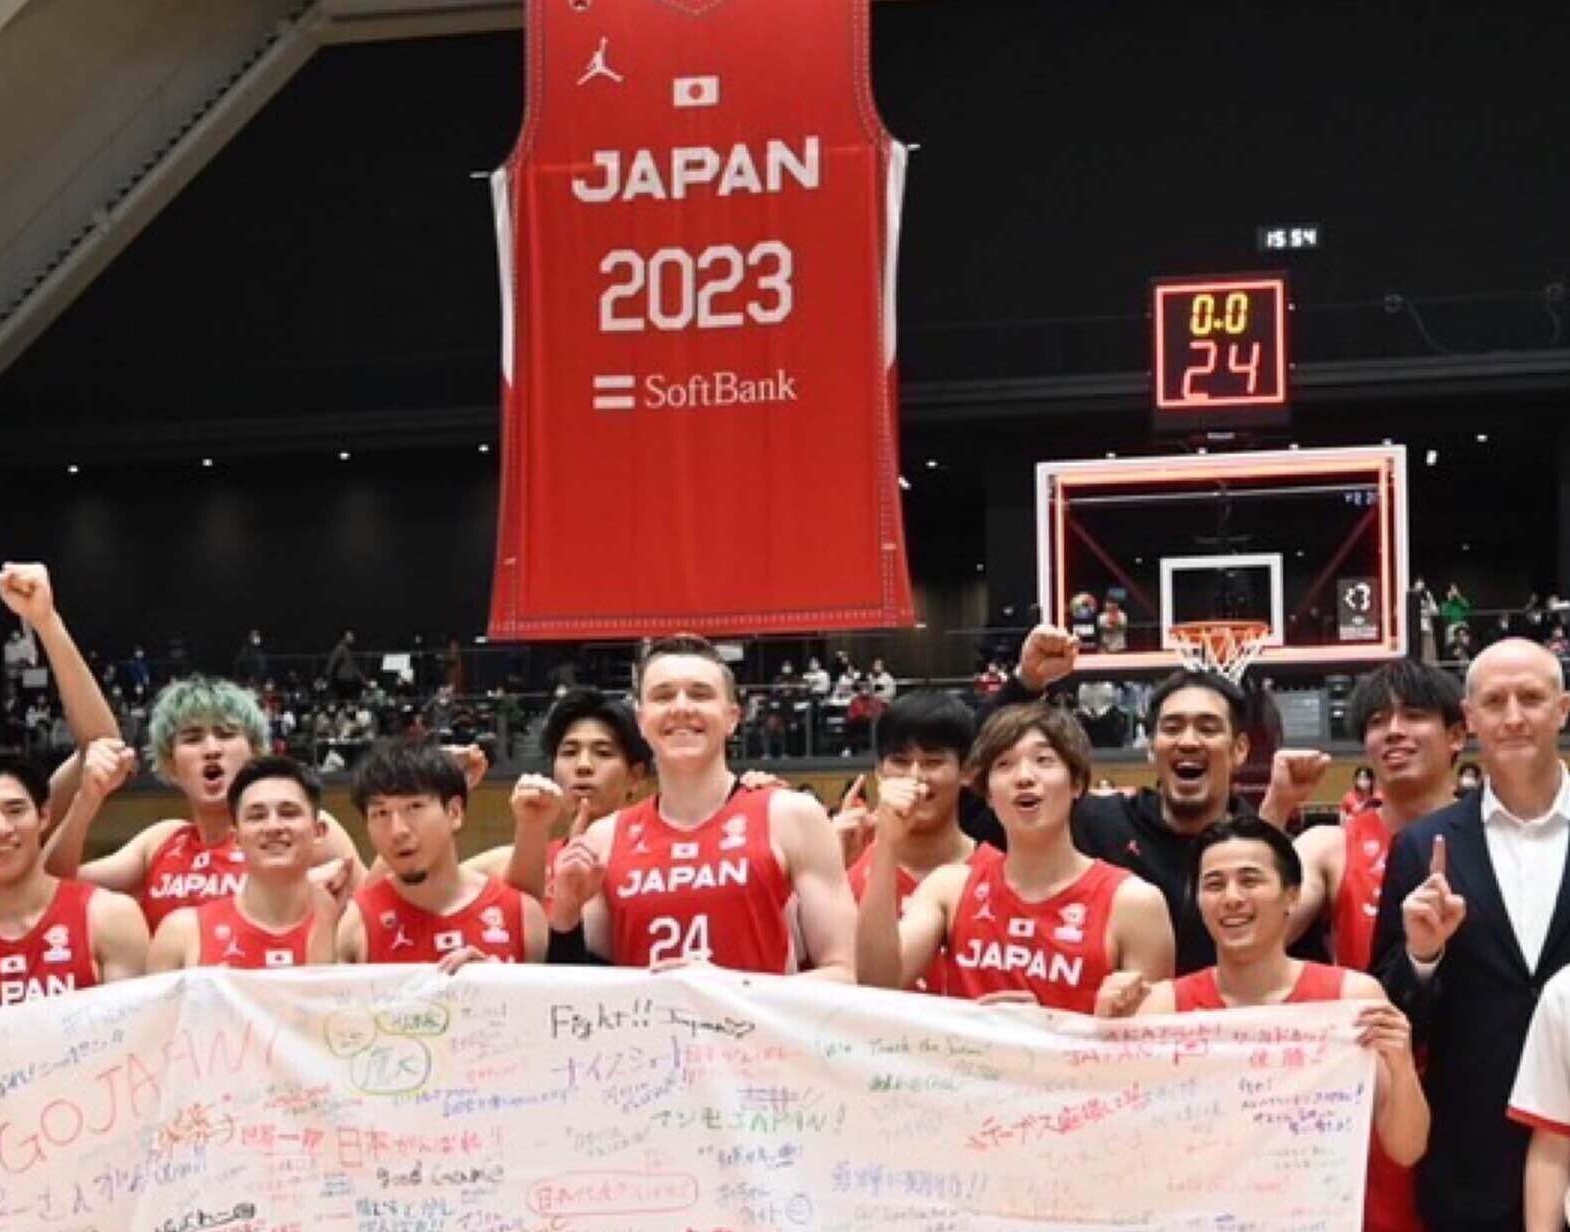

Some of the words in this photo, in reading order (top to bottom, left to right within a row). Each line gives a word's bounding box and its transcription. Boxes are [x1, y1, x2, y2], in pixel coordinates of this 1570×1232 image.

[572, 136, 820, 202] JAPAN
[599, 240, 792, 331] 2023
[1190, 293, 1248, 335] 0.0
[644, 369, 797, 408] SoftBank
[1182, 341, 1260, 399] 24
[151, 872, 248, 899] JAPAN
[616, 858, 748, 898] JAPAN
[647, 914, 713, 966] 24
[956, 938, 1083, 986] JAPAN
